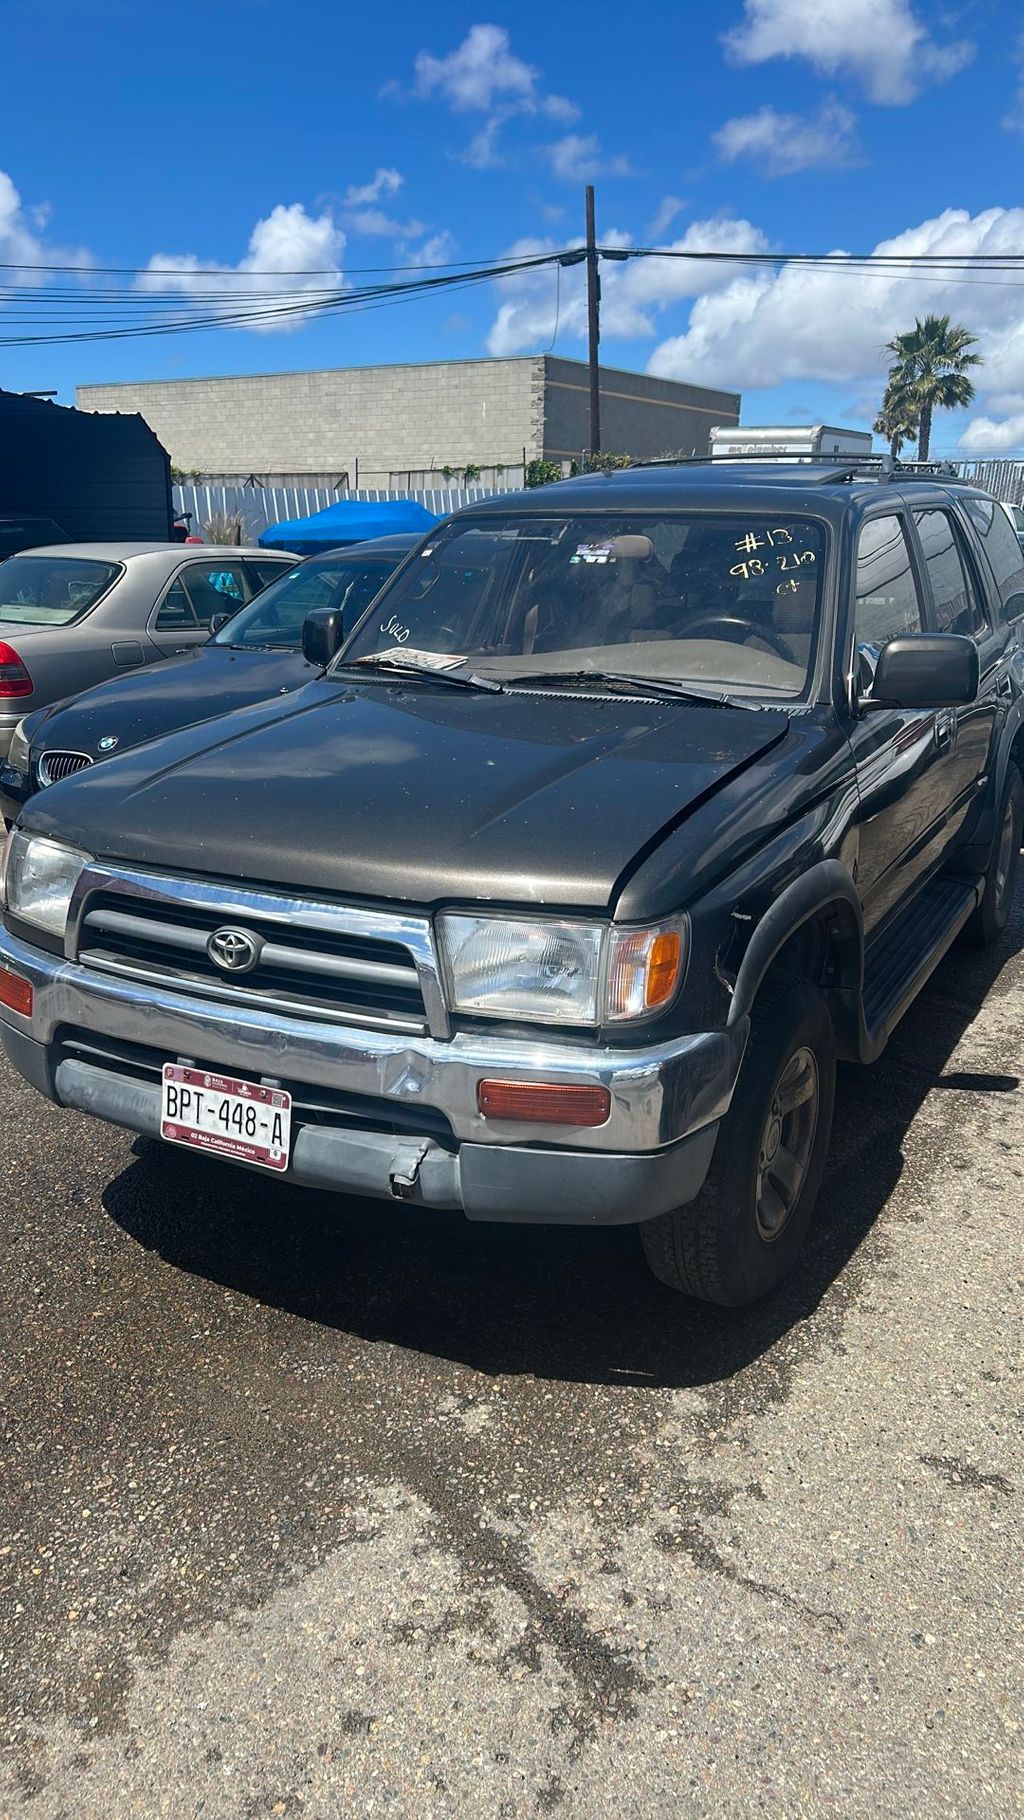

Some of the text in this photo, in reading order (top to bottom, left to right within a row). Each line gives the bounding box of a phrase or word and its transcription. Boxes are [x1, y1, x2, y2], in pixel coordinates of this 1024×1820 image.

[166, 1084, 283, 1147] BPT-448-A
[198, 1133, 210, 1143] Baja
[210, 1137, 236, 1150] California
[236, 1144, 256, 1155] México
